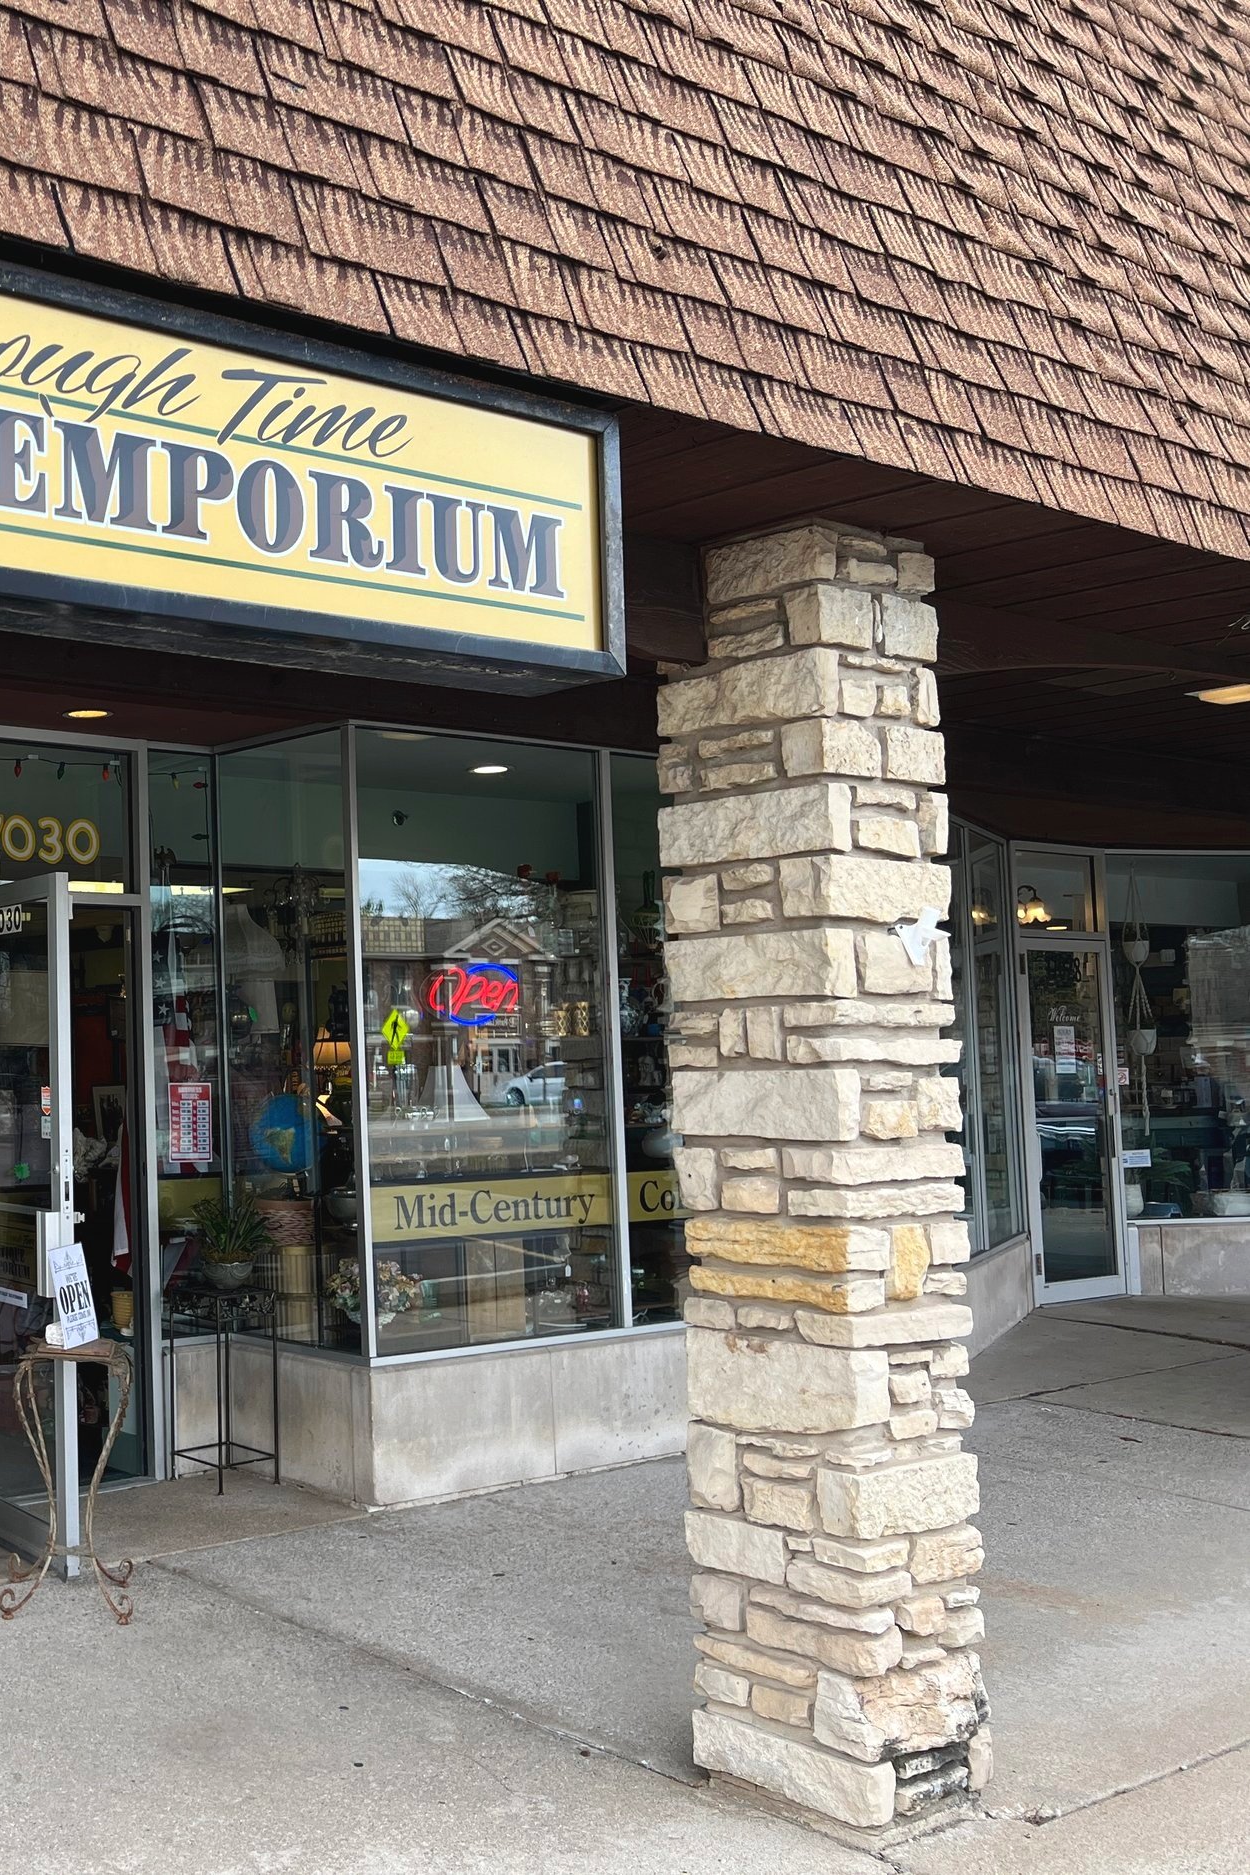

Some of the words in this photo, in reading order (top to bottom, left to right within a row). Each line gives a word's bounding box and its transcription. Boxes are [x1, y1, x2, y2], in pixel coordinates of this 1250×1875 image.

[216, 368, 413, 457] Time
[429, 966, 520, 1016] Open
[1047, 1005, 1081, 1022] Welcome
[393, 1188, 596, 1231] Mid-Century
[59, 1280, 92, 1315] OPEN
